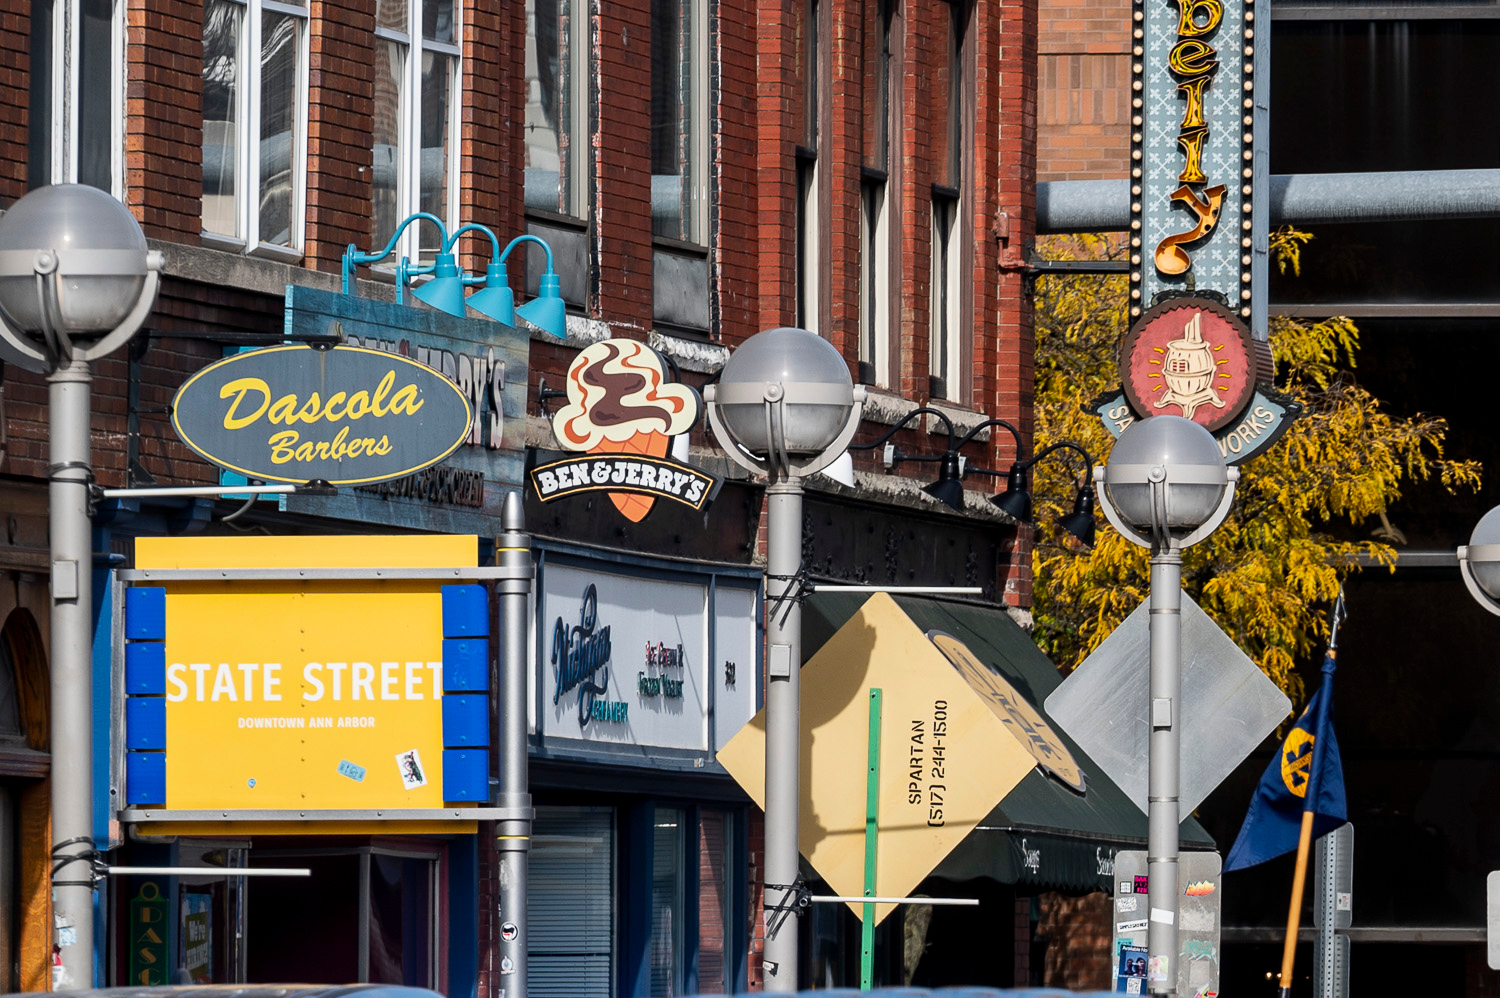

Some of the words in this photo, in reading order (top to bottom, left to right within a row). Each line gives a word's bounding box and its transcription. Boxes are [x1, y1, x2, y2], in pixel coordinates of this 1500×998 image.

[219, 370, 424, 430] Dascola
[268, 426, 393, 464] Barbers
[166, 662, 282, 702] STATE
[303, 662, 443, 701] STREET
[238, 717, 305, 729] DOWNTOWN
[309, 716, 333, 729] ANN
[337, 716, 376, 729] ARBOR
[931, 699, 948, 779] 244-1500
[908, 720, 925, 805] SPARTAN
[927, 784, 947, 828] (517)
